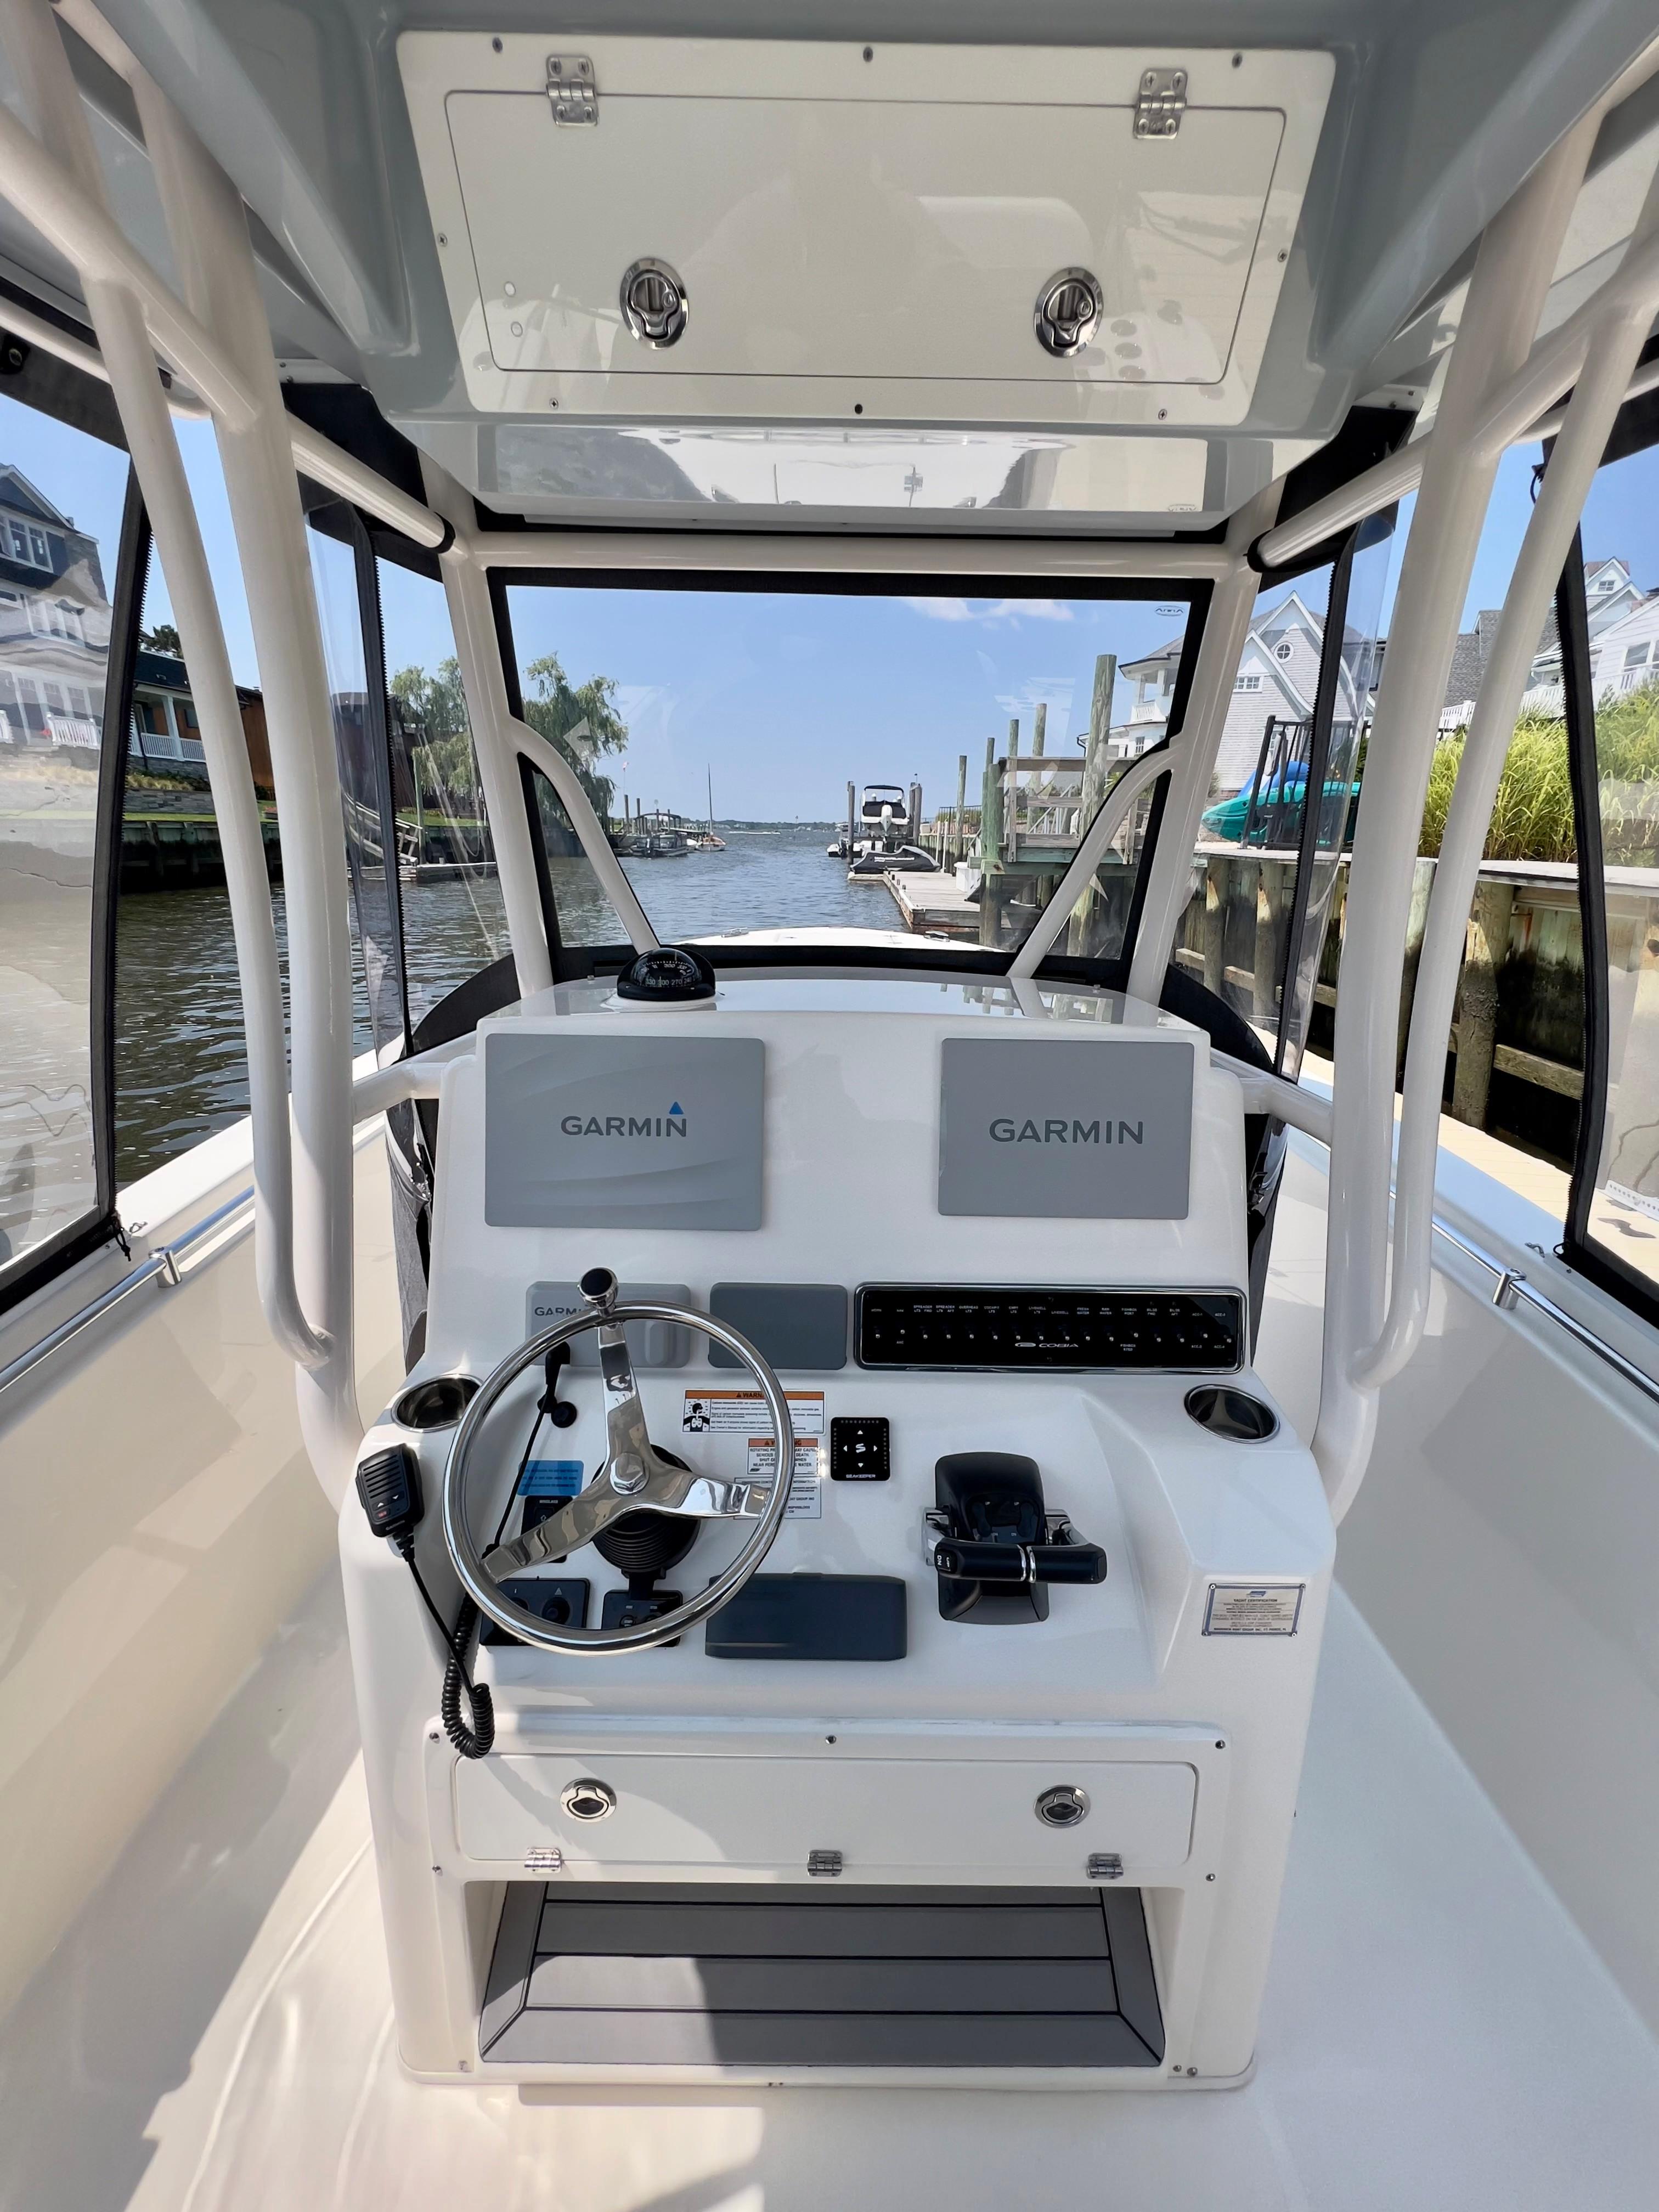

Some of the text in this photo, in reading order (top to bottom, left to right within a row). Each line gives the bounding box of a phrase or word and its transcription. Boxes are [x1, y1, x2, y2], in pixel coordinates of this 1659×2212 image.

[561, 1116, 687, 1137] GARMIN
[989, 1118, 1144, 1144] GARMIN
[534, 1307, 582, 1316] GARM
[937, 1555, 942, 1566] DN
